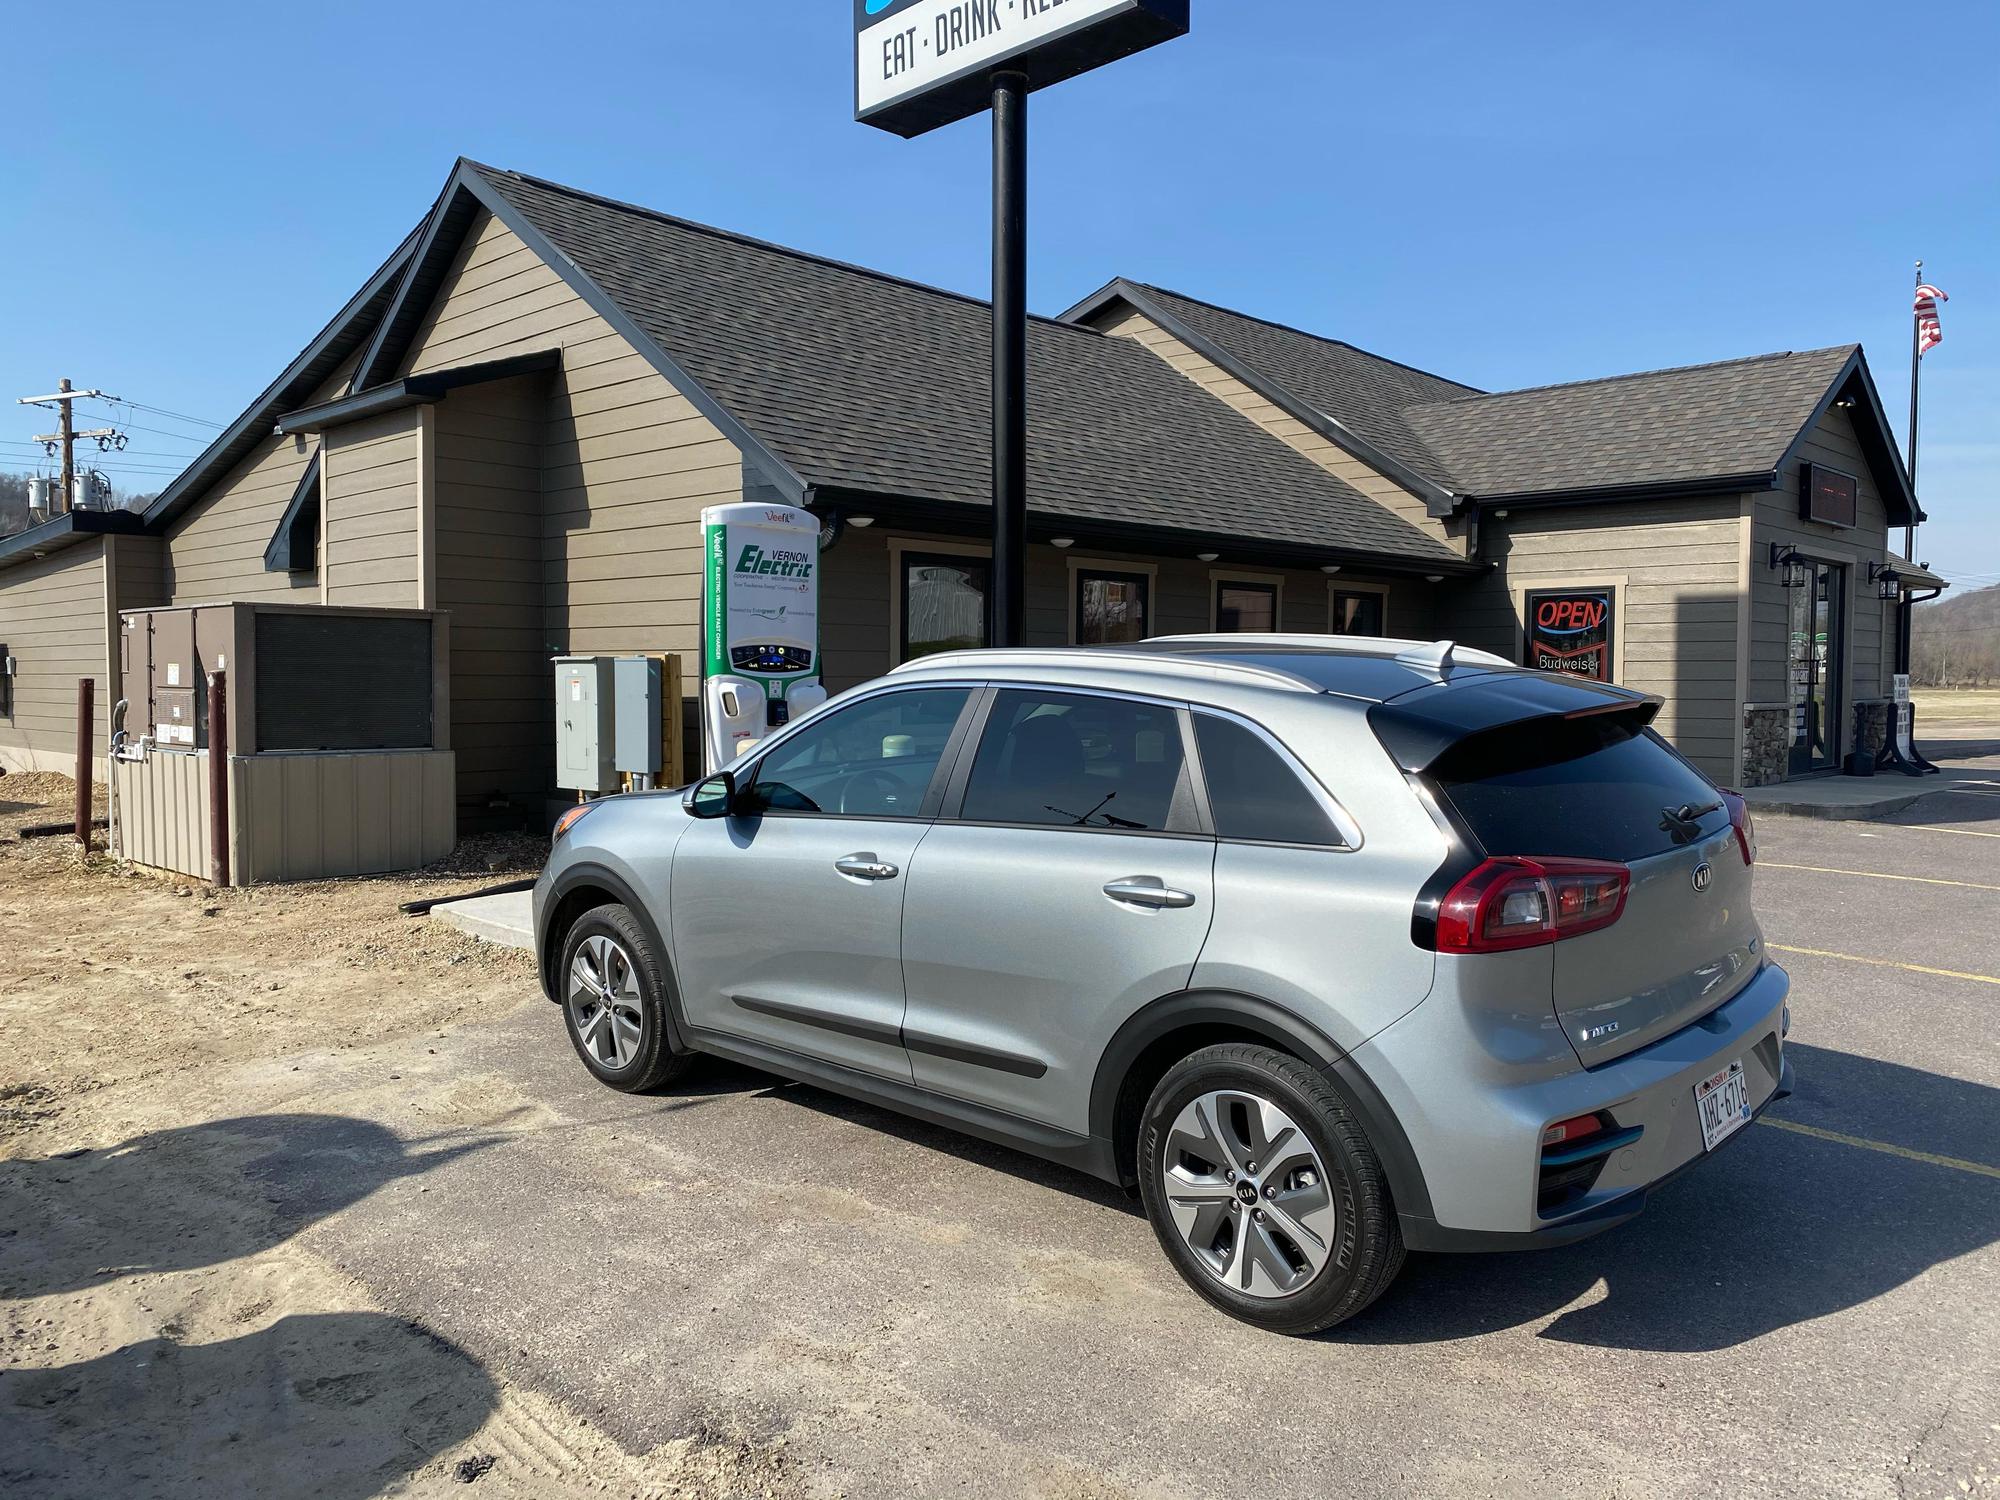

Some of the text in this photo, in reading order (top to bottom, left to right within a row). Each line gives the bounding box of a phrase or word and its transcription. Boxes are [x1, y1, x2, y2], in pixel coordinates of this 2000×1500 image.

[883, 0, 1002, 81] EAT DRINK
[735, 544, 813, 578] Electric
[772, 549, 809, 563] VERNON
[1538, 602, 1603, 627] OPEN
[1539, 655, 1599, 670] Budweiser
[1696, 867, 1712, 888] KIA
[1238, 1188, 1256, 1199] KIA
